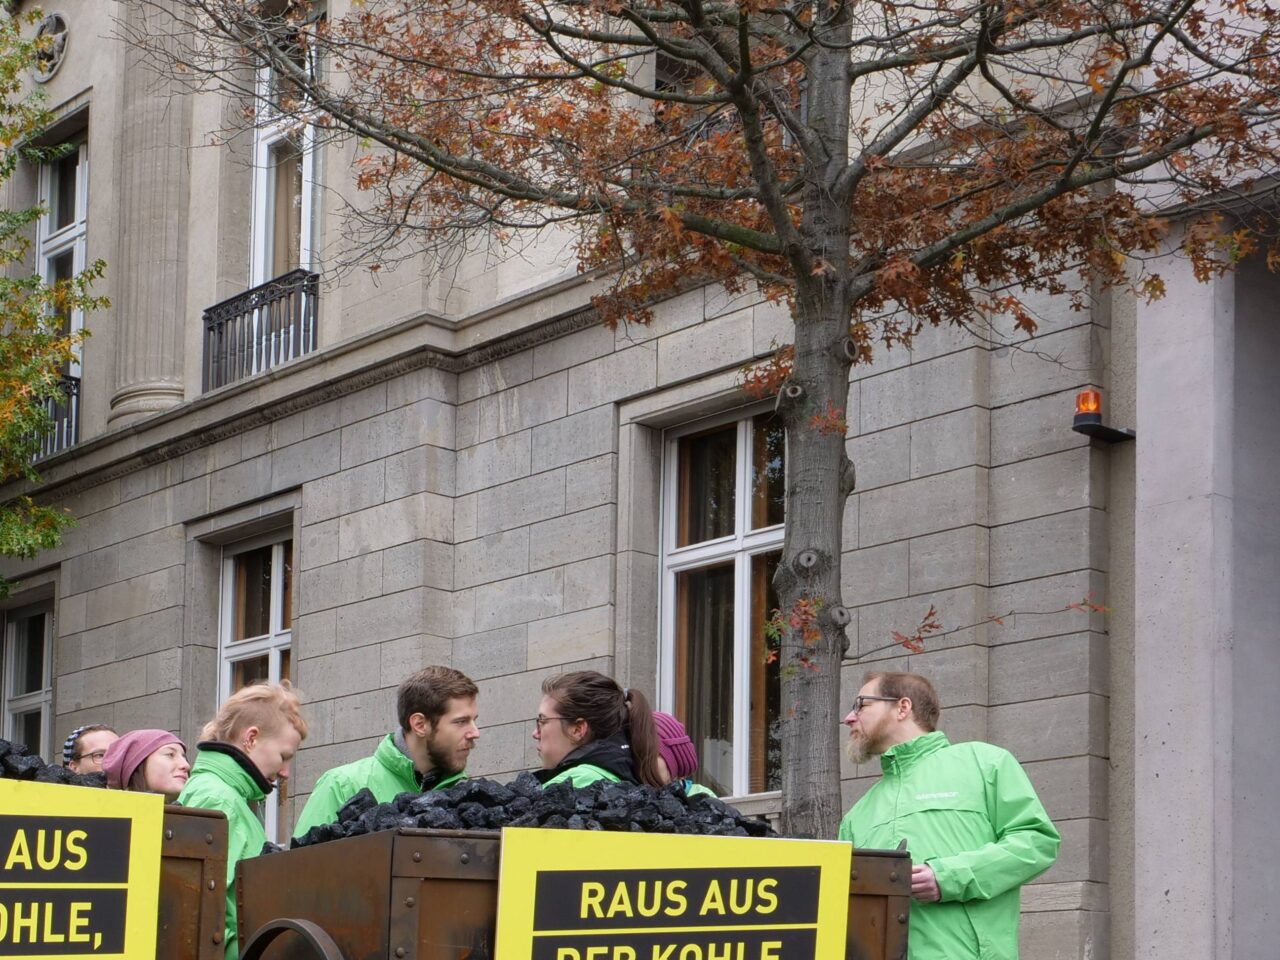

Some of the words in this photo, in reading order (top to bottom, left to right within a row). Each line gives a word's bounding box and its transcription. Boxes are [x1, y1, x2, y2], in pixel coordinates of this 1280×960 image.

[4, 829, 88, 871] AUS
[580, 879, 688, 919] RAUS
[698, 877, 779, 916] AUS
